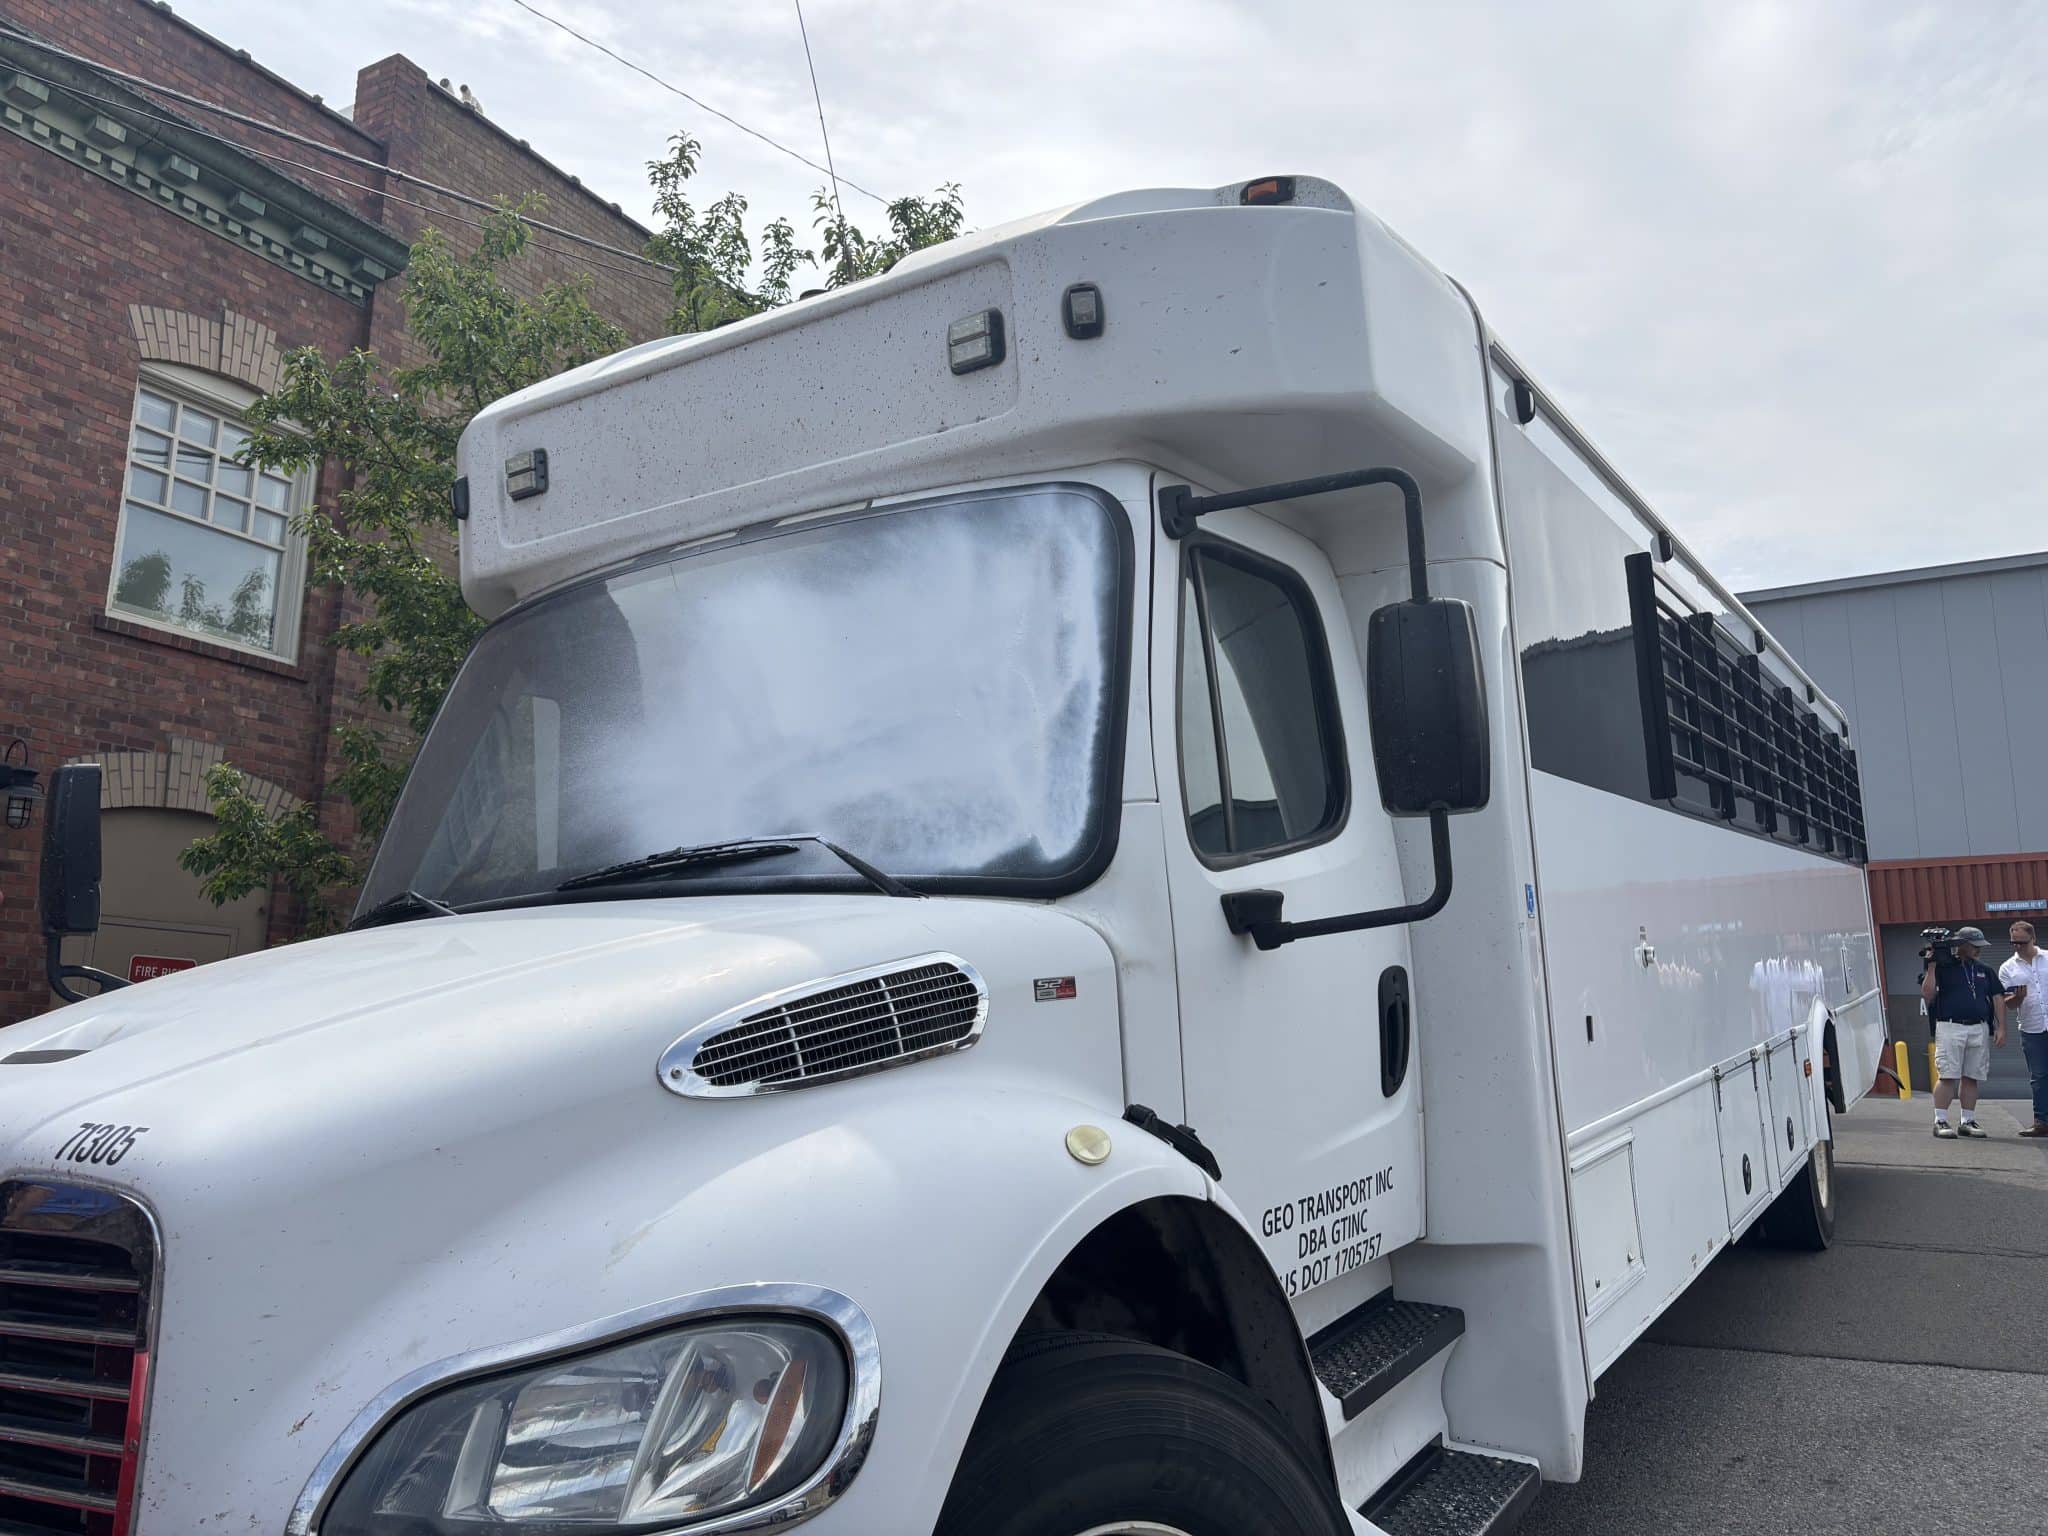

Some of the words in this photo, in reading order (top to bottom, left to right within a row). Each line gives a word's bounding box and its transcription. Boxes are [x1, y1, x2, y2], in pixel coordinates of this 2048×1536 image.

[135, 965, 158, 977] FIRE
[1919, 997, 1928, 1016] A
[54, 1122, 151, 1166] 71305
[1262, 1202, 1294, 1237] GEO
[1298, 1175, 1373, 1225] TRANSPORT
[1375, 1166, 1394, 1196] INC
[1298, 1225, 1327, 1260] DBA
[1331, 1208, 1368, 1245] GTINC
[1301, 1255, 1331, 1291] DOT
[1334, 1232, 1382, 1275] 1705757
